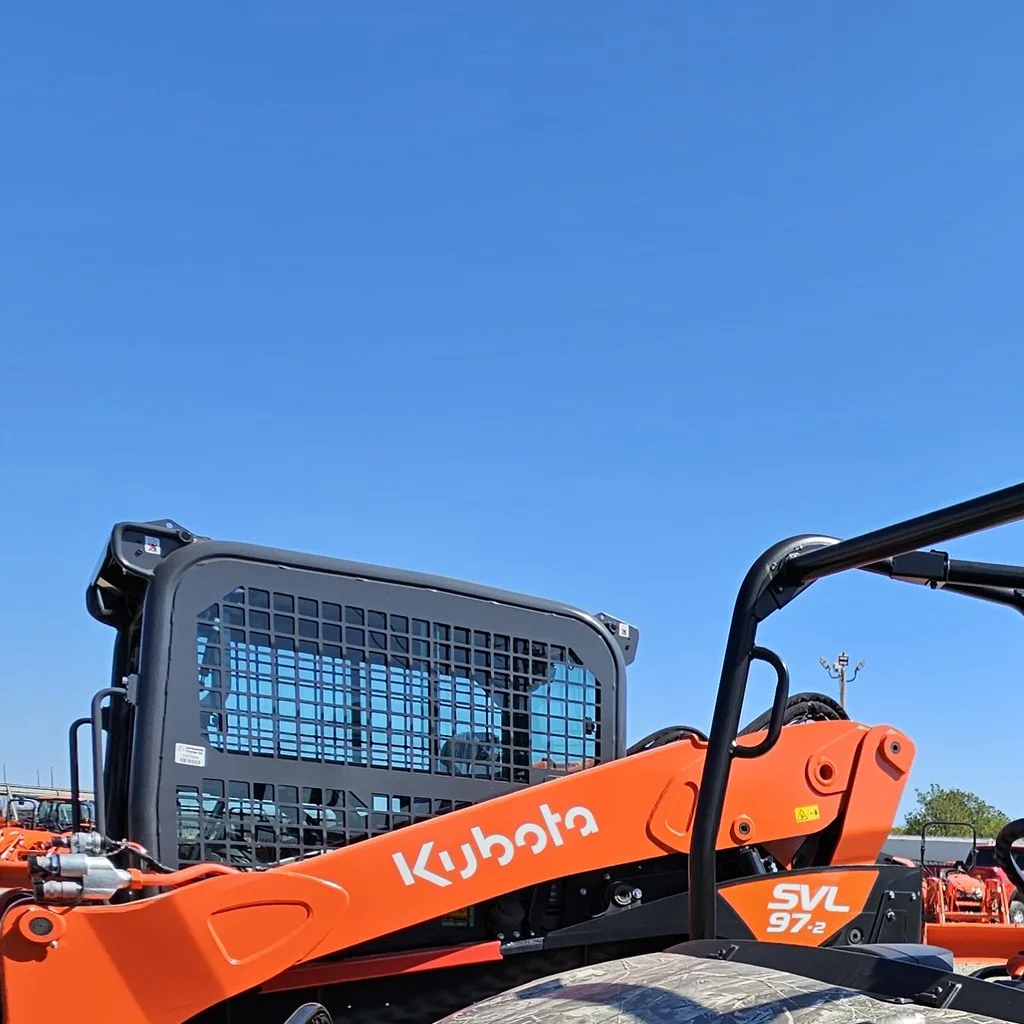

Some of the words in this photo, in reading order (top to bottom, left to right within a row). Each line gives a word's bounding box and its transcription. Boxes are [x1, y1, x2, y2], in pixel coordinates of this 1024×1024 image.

[391, 803, 600, 888] Kubota
[767, 883, 850, 912] SVL
[766, 912, 827, 934] 97-2
